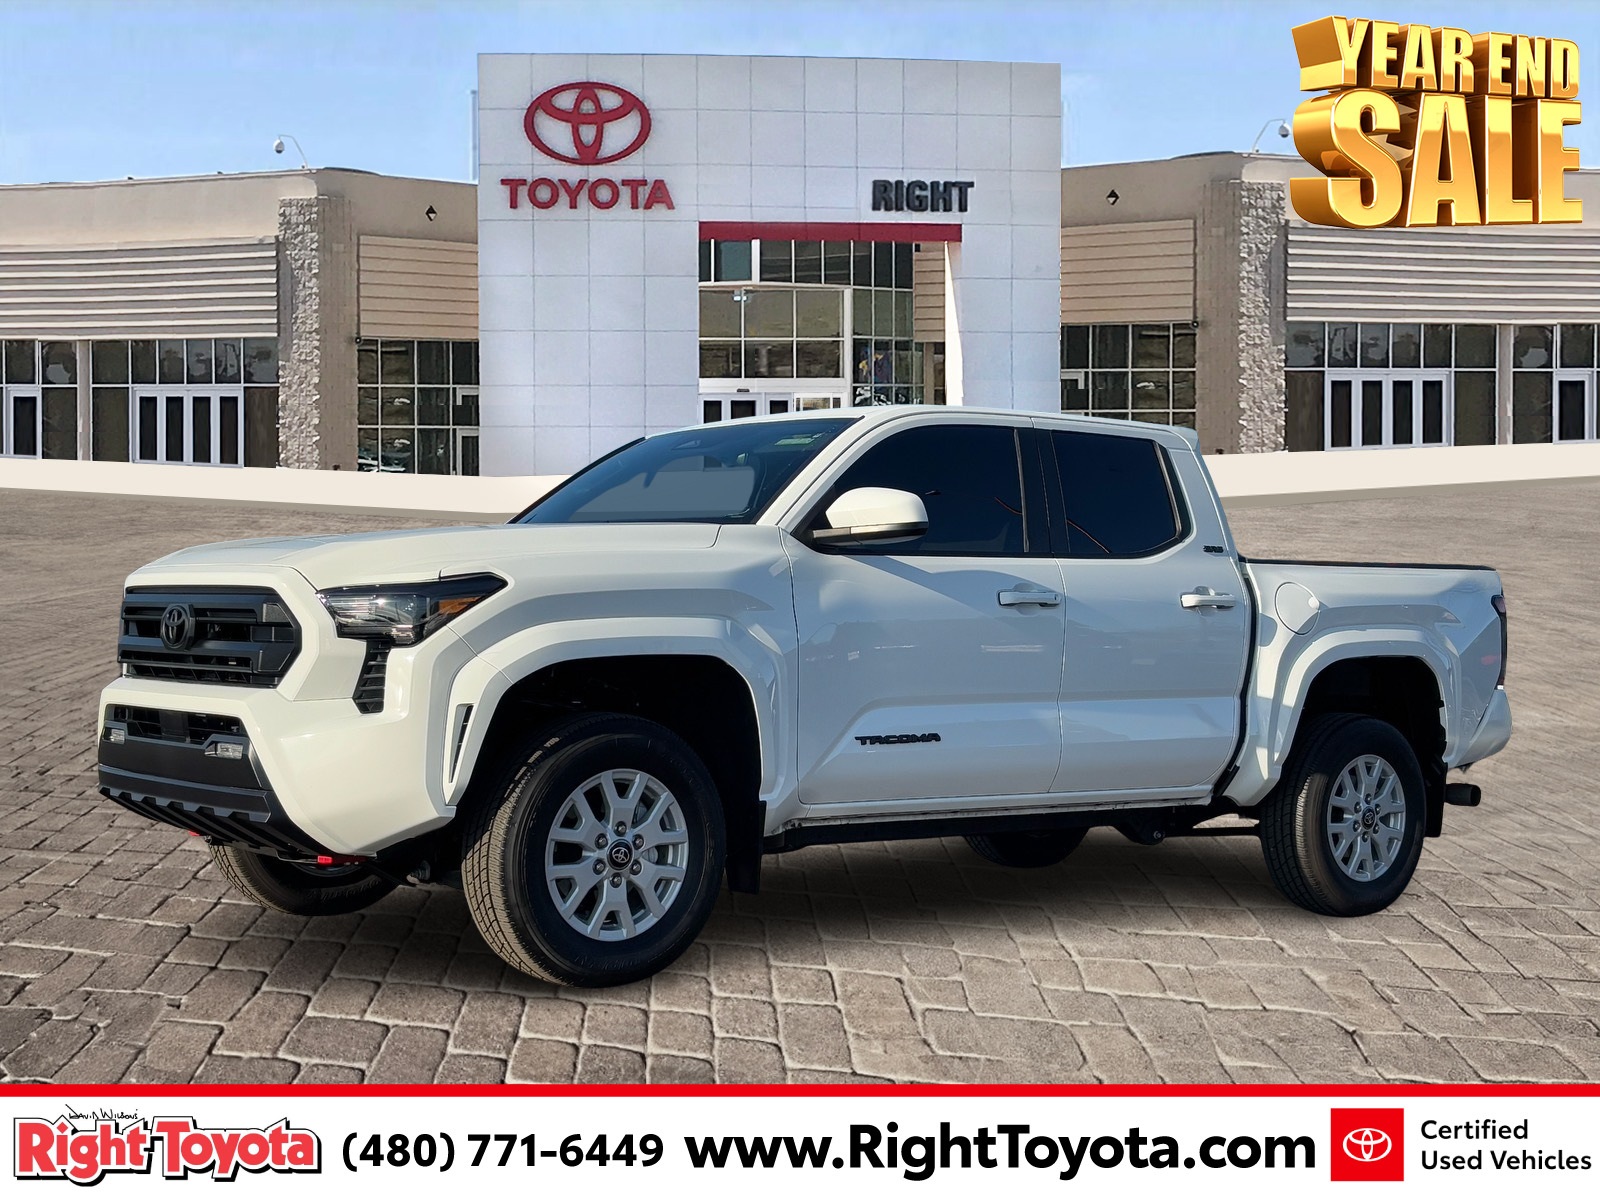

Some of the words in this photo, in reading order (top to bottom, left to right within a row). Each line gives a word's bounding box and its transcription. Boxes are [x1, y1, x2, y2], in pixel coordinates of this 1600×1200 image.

[501, 178, 675, 210] TOYOTA
[871, 179, 975, 212] RIGHT
[854, 732, 942, 746] TACOMA
